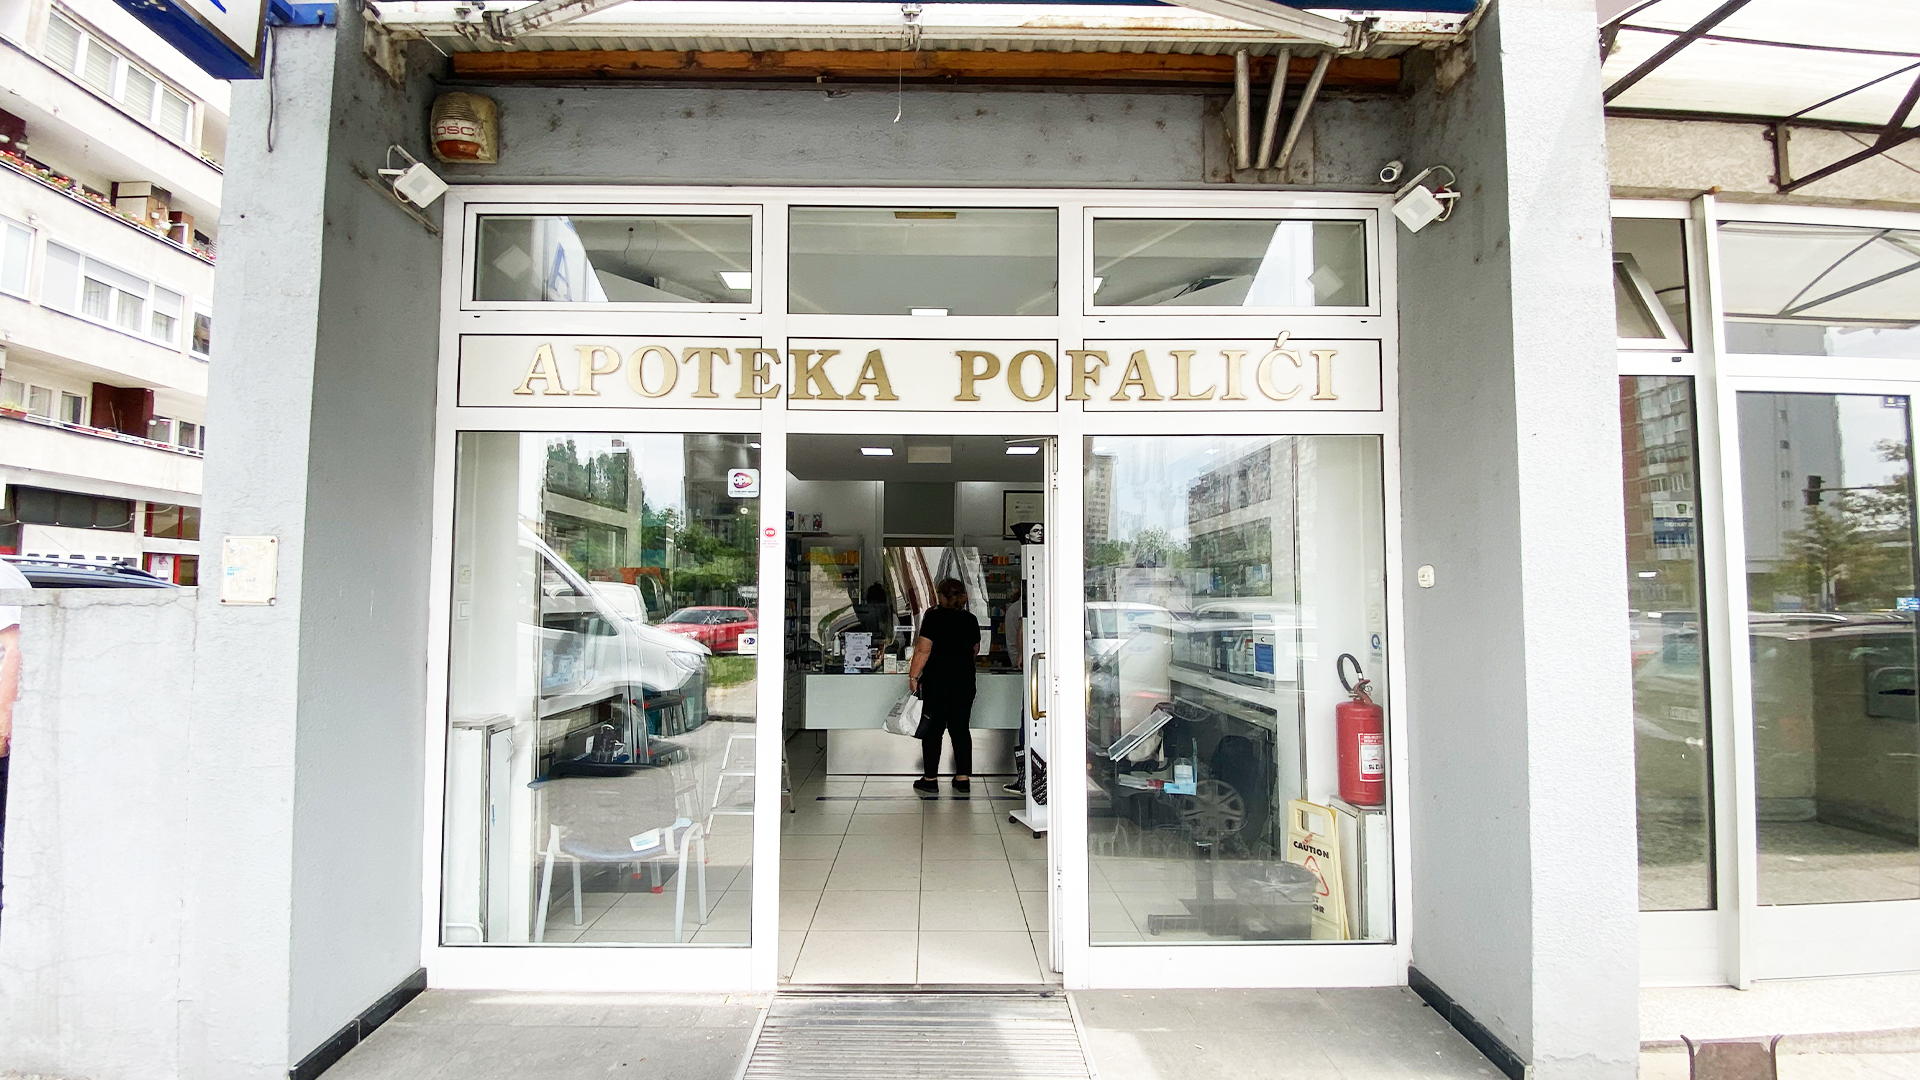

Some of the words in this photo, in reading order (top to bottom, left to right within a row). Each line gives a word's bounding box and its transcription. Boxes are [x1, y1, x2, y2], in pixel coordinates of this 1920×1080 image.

[437, 126, 475, 136] DSC
[513, 342, 899, 401] APOTEKA
[954, 330, 1339, 402] POFALIĆI
[1293, 841, 1330, 859] CAUTION
